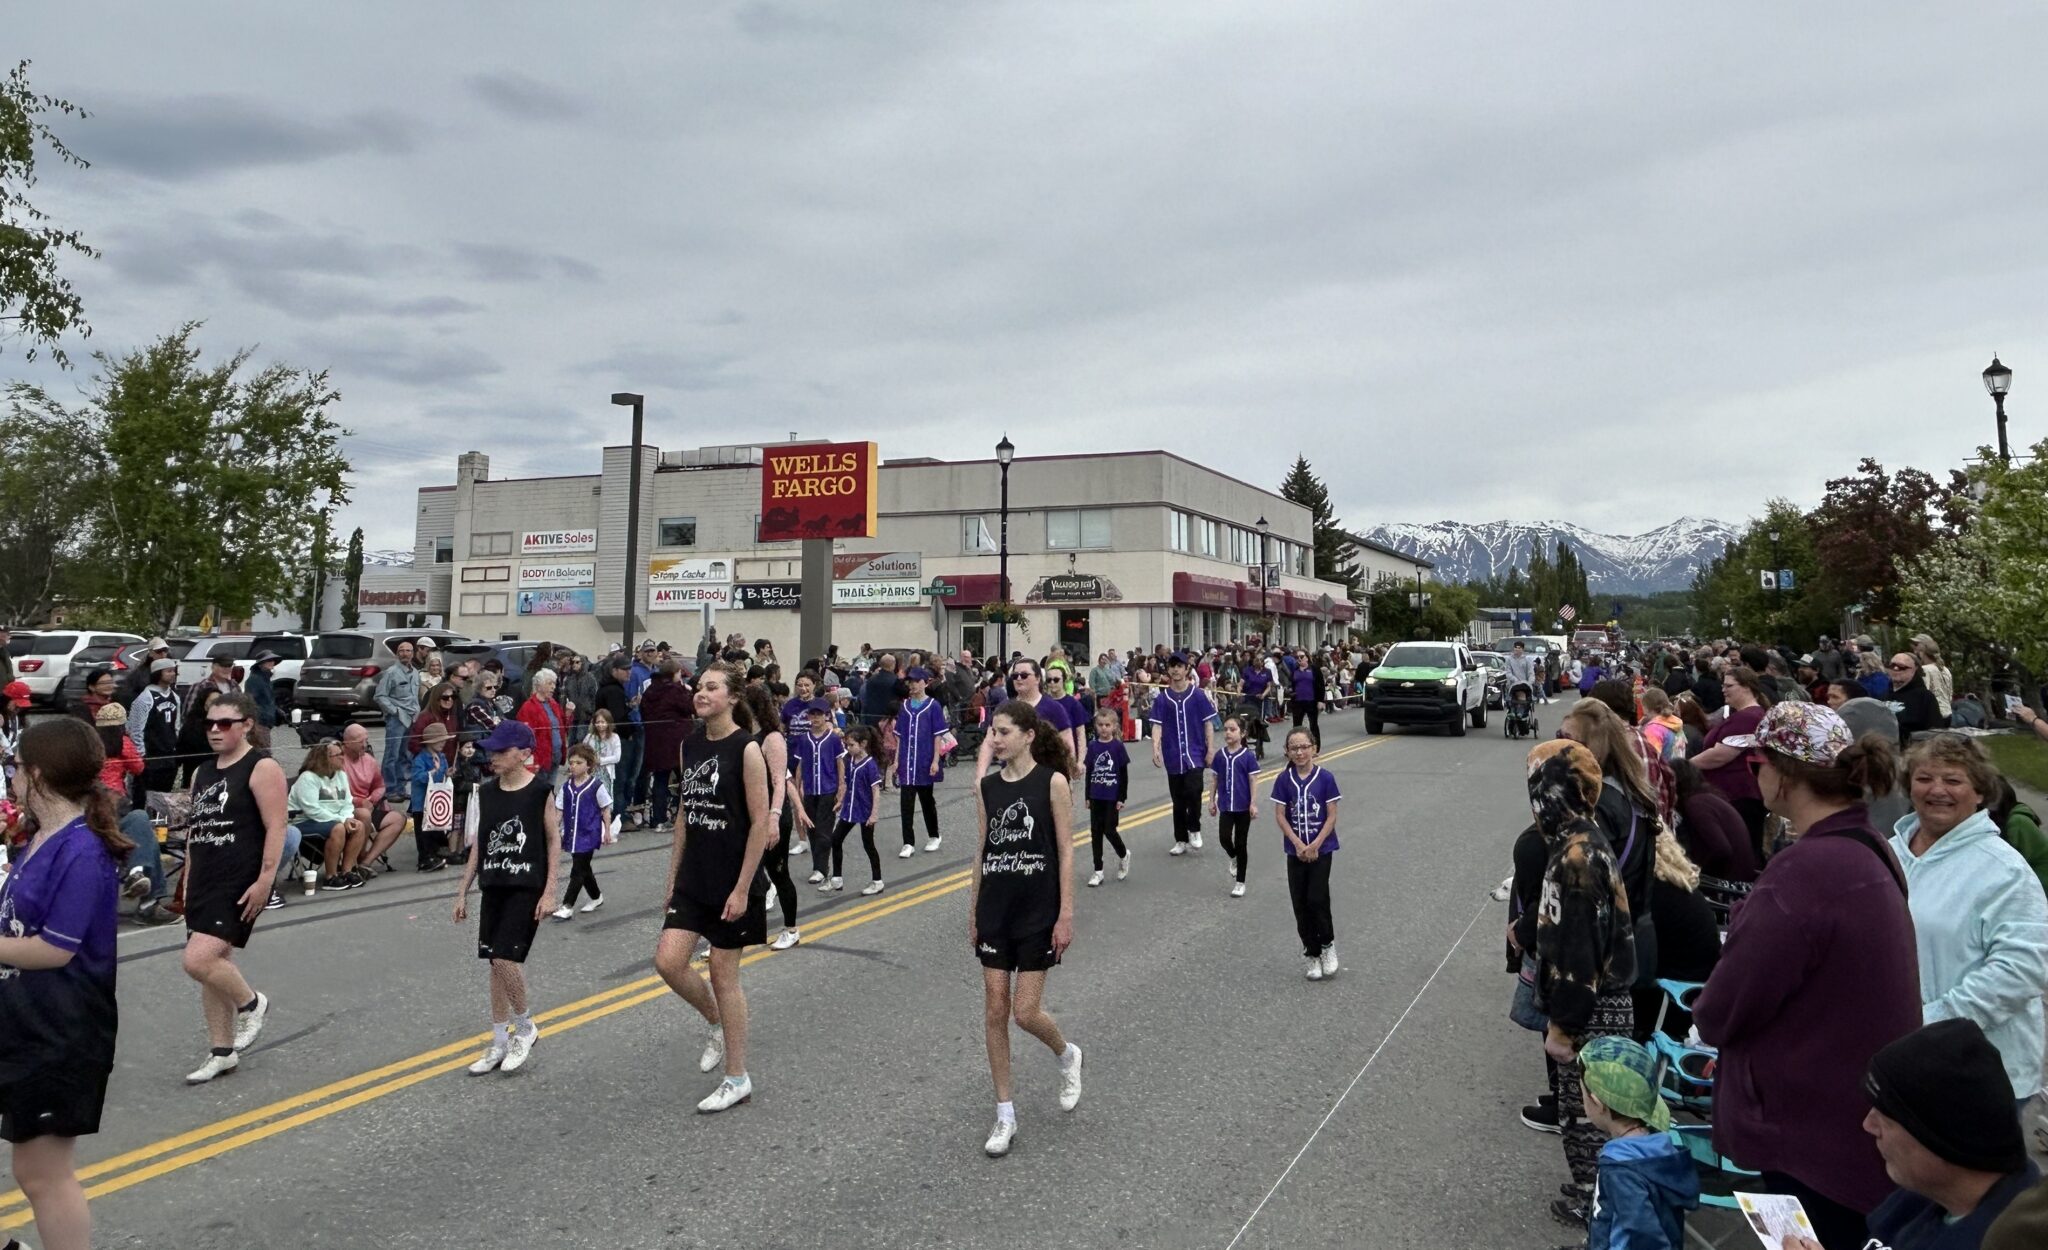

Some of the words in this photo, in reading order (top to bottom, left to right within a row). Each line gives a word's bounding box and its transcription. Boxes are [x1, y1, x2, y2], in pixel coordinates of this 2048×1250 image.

[770, 453, 857, 475] WELLS
[772, 476, 856, 498] FARGO
[524, 534, 563, 545] AKTIVE
[564, 532, 593, 543] Soles
[868, 560, 917, 571] Solutions
[522, 569, 547, 578] BODY
[547, 569, 555, 577] In
[556, 567, 592, 577] Balance
[656, 589, 696, 601] AKTIVE
[697, 588, 727, 602] Body
[837, 588, 874, 597] TRAILS
[880, 586, 915, 597] PARKS
[547, 602, 563, 612] SPA
